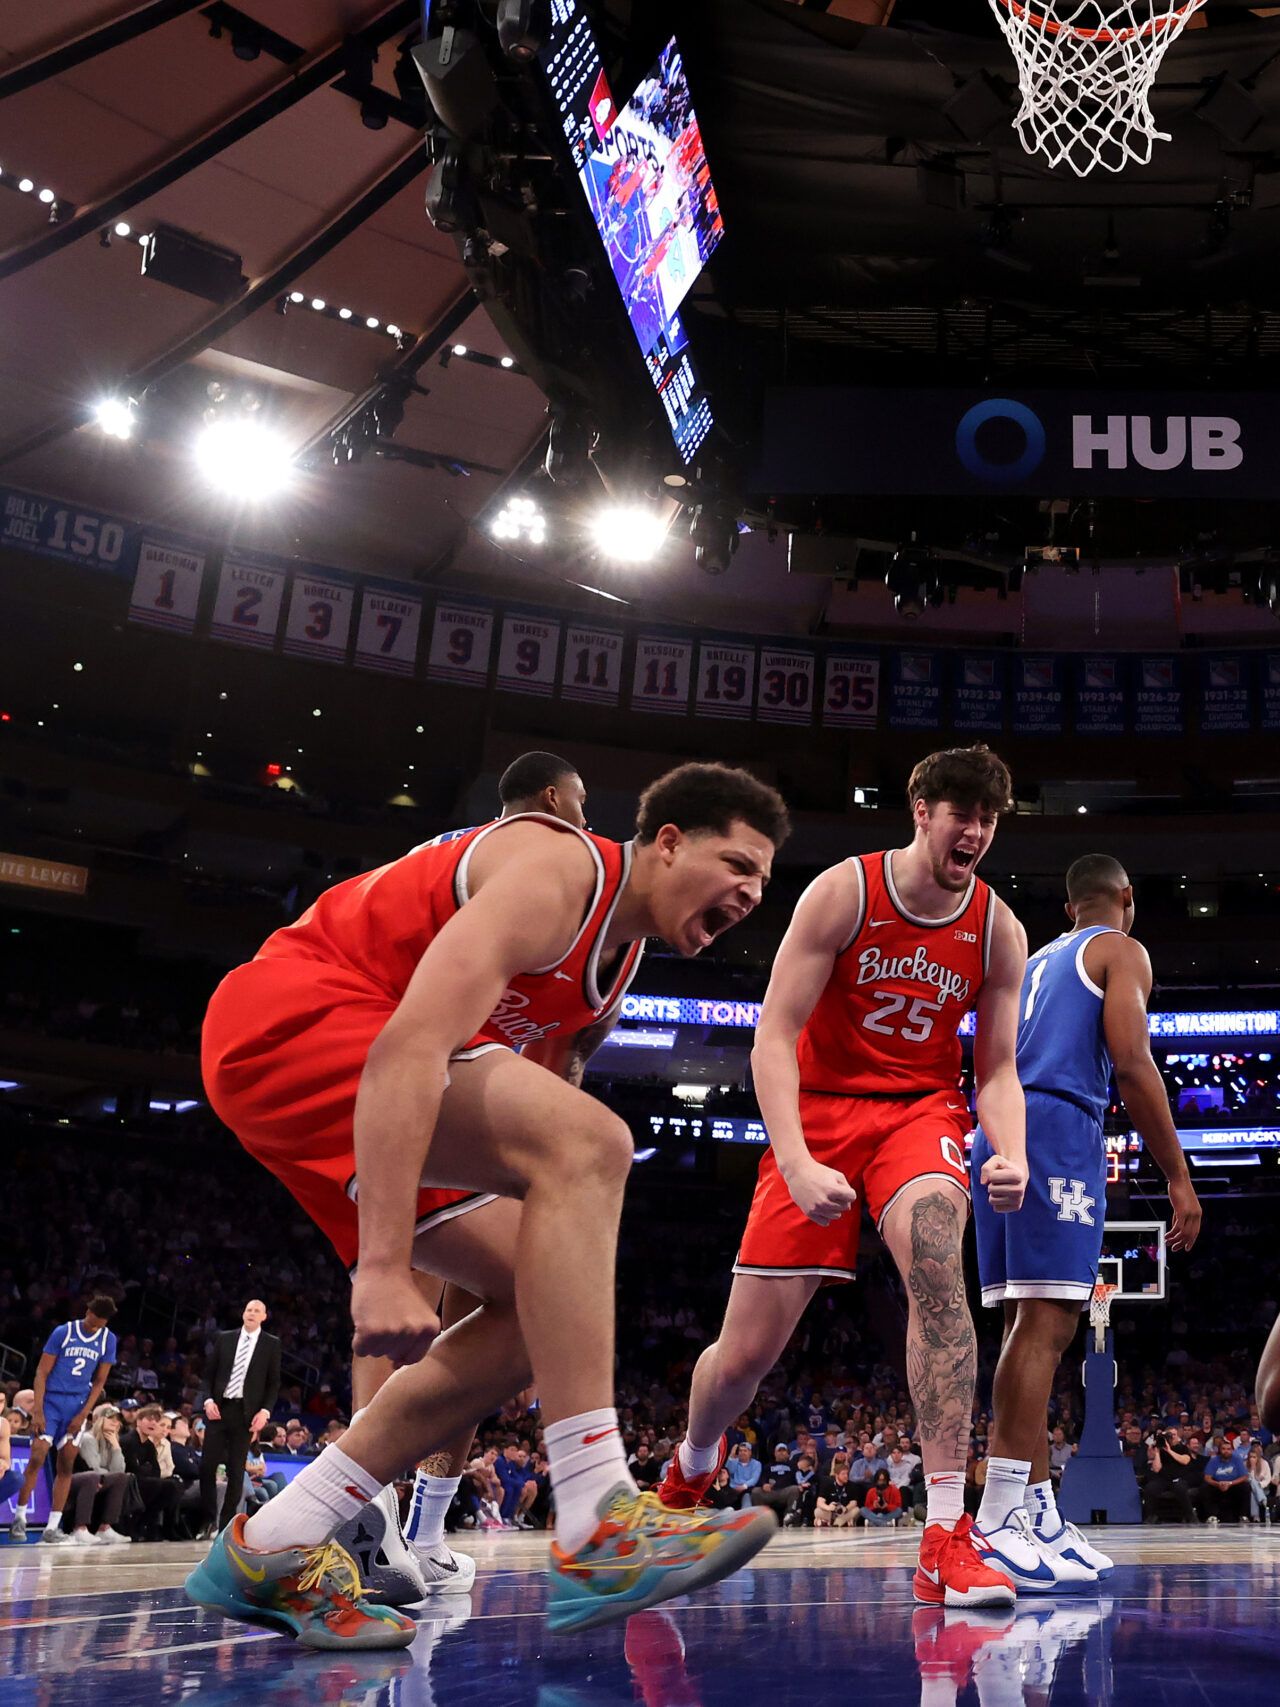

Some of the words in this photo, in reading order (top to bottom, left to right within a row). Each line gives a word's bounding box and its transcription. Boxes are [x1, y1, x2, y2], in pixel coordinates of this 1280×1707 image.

[1072, 415, 1244, 471] HUB
[5, 495, 48, 522] BILLY
[3, 518, 40, 542] JOEL
[47, 510, 125, 562] 150
[154, 569, 176, 609] 1
[232, 586, 263, 627] 2
[305, 601, 333, 640] 3
[376, 615, 403, 652] 7
[447, 628, 474, 665] 9
[515, 638, 541, 676] 9
[573, 648, 609, 686] 11
[642, 658, 678, 697] 11
[704, 663, 747, 701] 19
[763, 669, 810, 707] 30
[827, 675, 875, 712] 35
[0, 860, 25, 879] ITE
[31, 865, 79, 887] LEVEL
[857, 946, 970, 1005] Buckeyes
[1024, 959, 1048, 1021] 1
[621, 997, 680, 1020] ORTS
[862, 991, 943, 1043] 25
[1175, 1013, 1276, 1033] WASHINGTON
[1048, 1177, 1095, 1227] UK
[65, 1346, 99, 1361] KENTUCKY
[72, 1357, 86, 1376] 2
